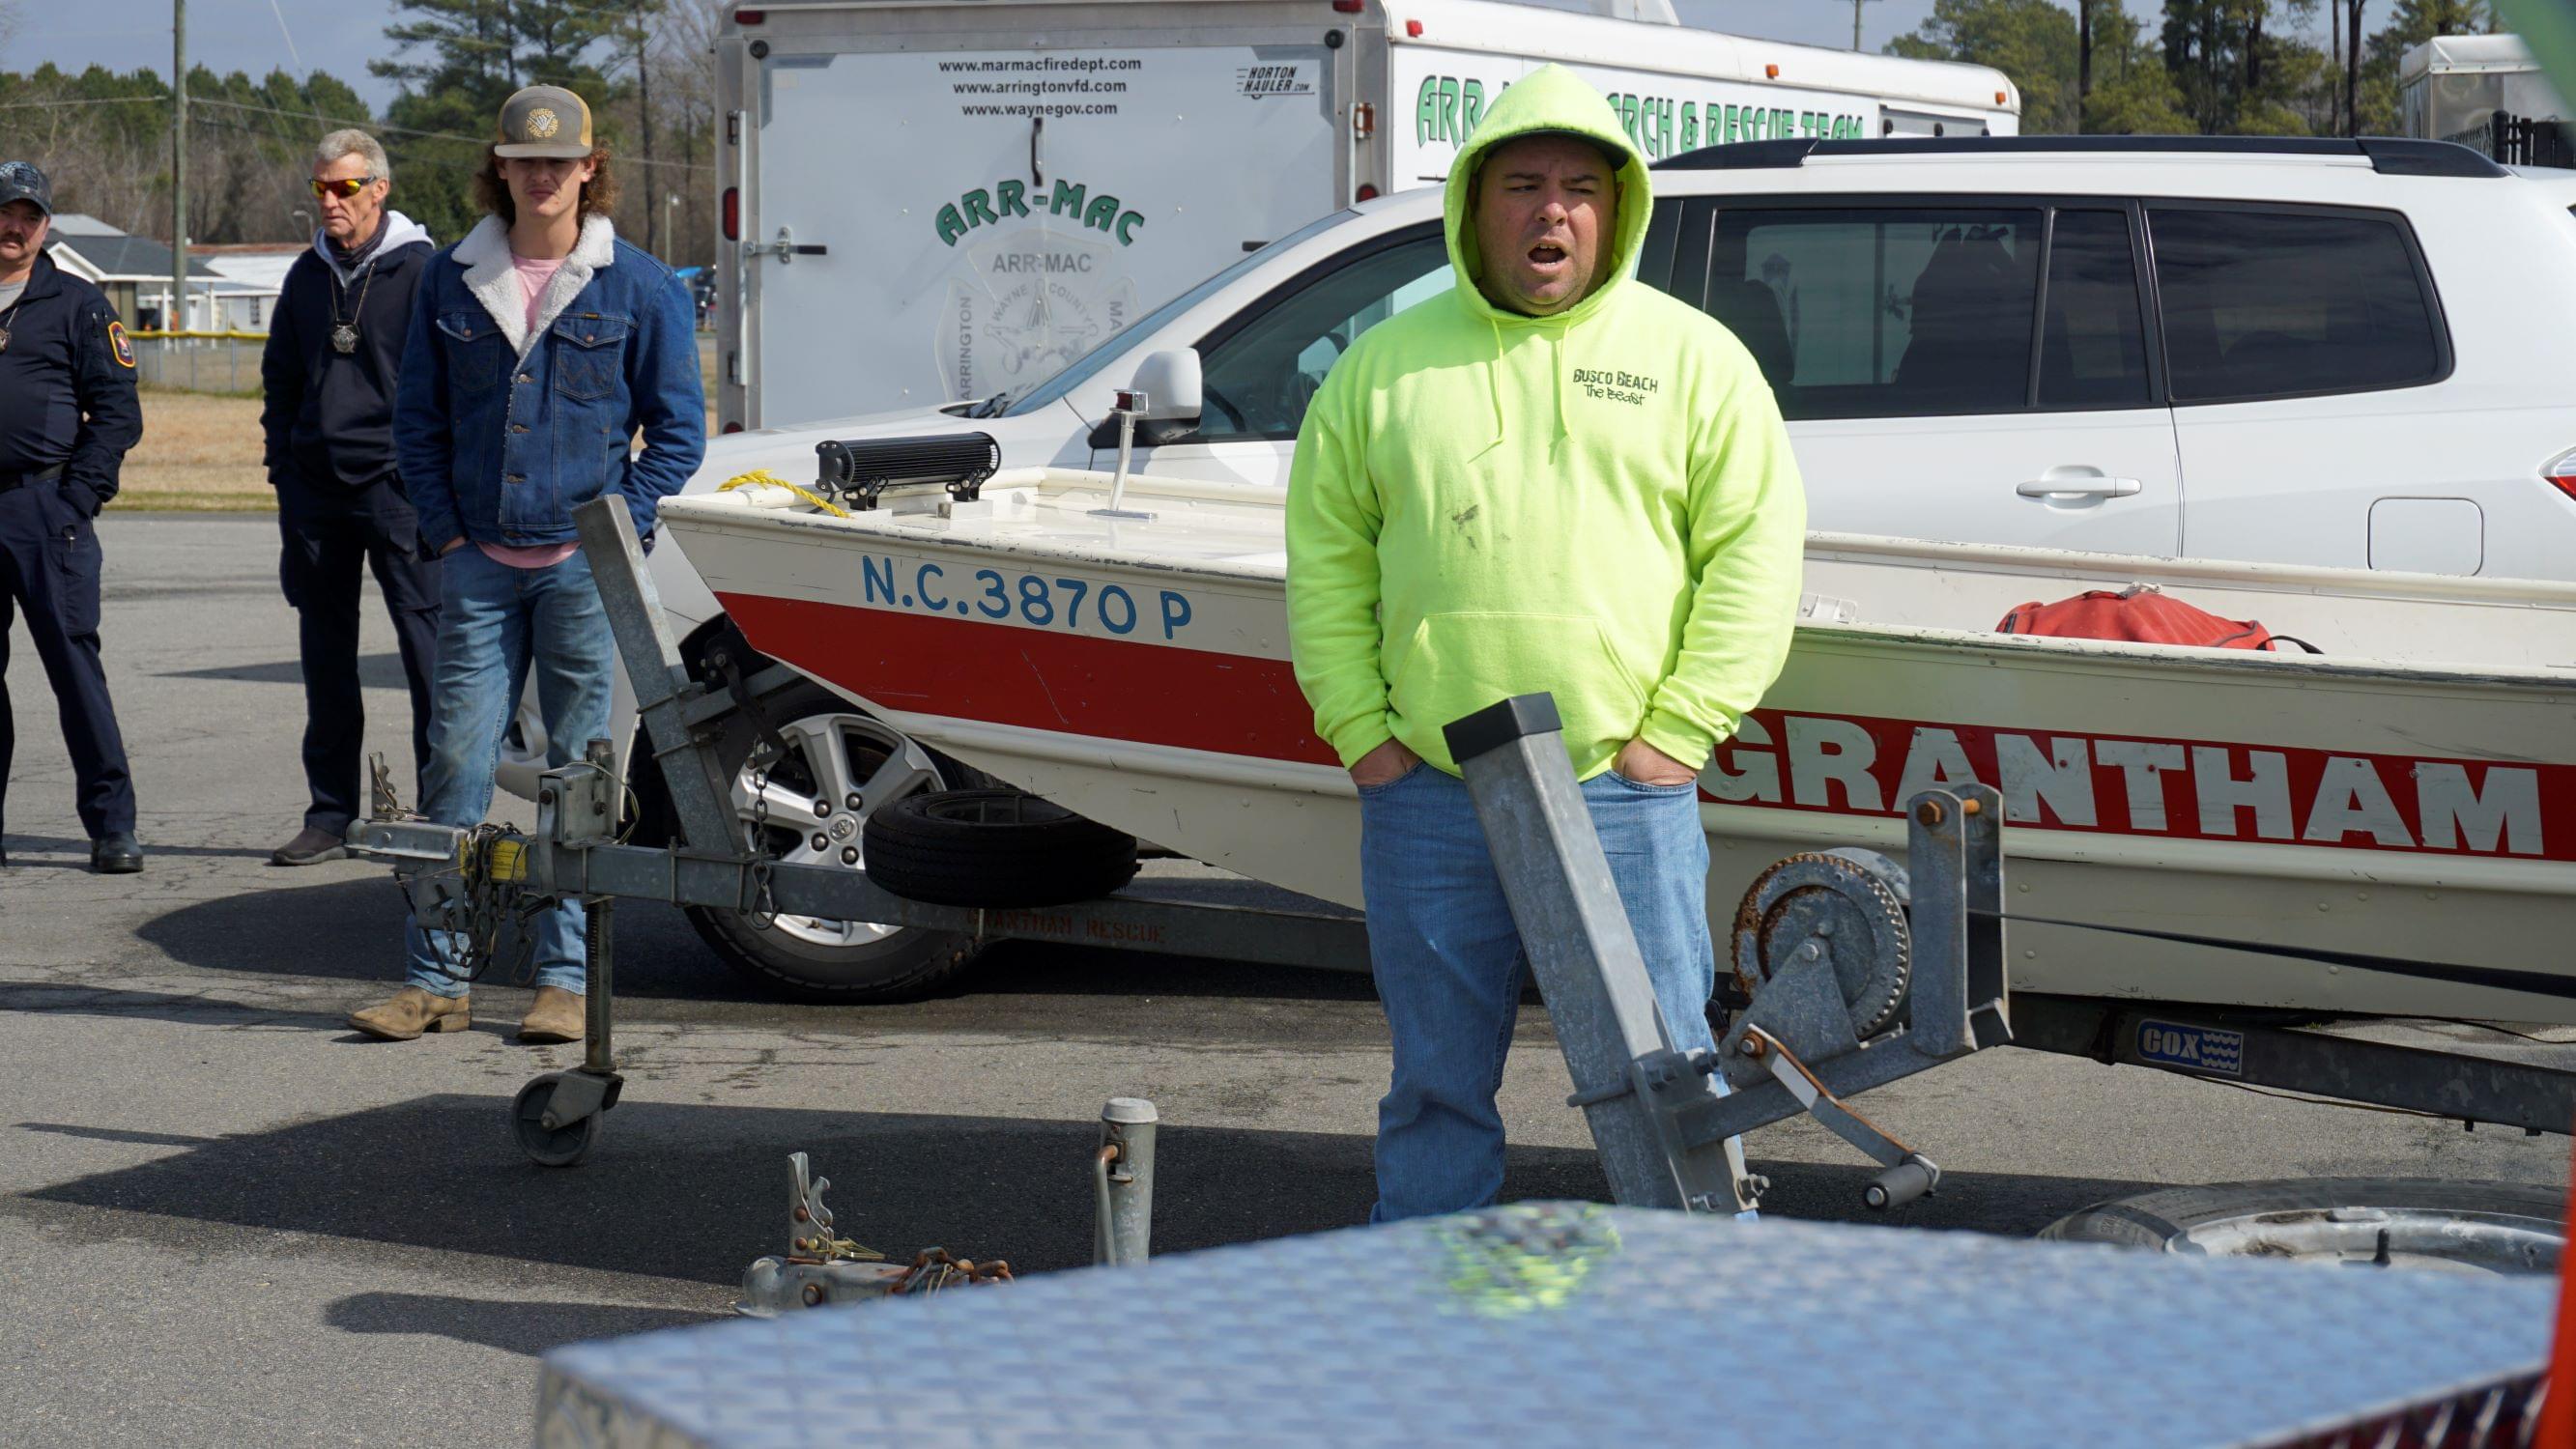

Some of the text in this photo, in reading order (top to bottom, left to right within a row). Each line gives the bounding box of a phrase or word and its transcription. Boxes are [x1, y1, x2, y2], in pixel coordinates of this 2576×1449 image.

[938, 58, 1142, 73] www.marmacfiredept.com
[1248, 66, 1298, 79] HORTON
[953, 80, 1128, 96] www.arringtonvfd.com
[961, 103, 1118, 118] www.waynegov.com
[935, 179, 1145, 247] ARR-MAC
[991, 282, 1094, 324] WAYNE COUNTY
[1109, 300, 1123, 331] MA
[959, 296, 973, 401] ARRINGTON
[1573, 368, 1658, 394] BUSCO BEACH
[1159, 589, 1192, 639] P
[1698, 712, 2544, 855] GRANTHAM
[2142, 1028, 2200, 1060] COX
